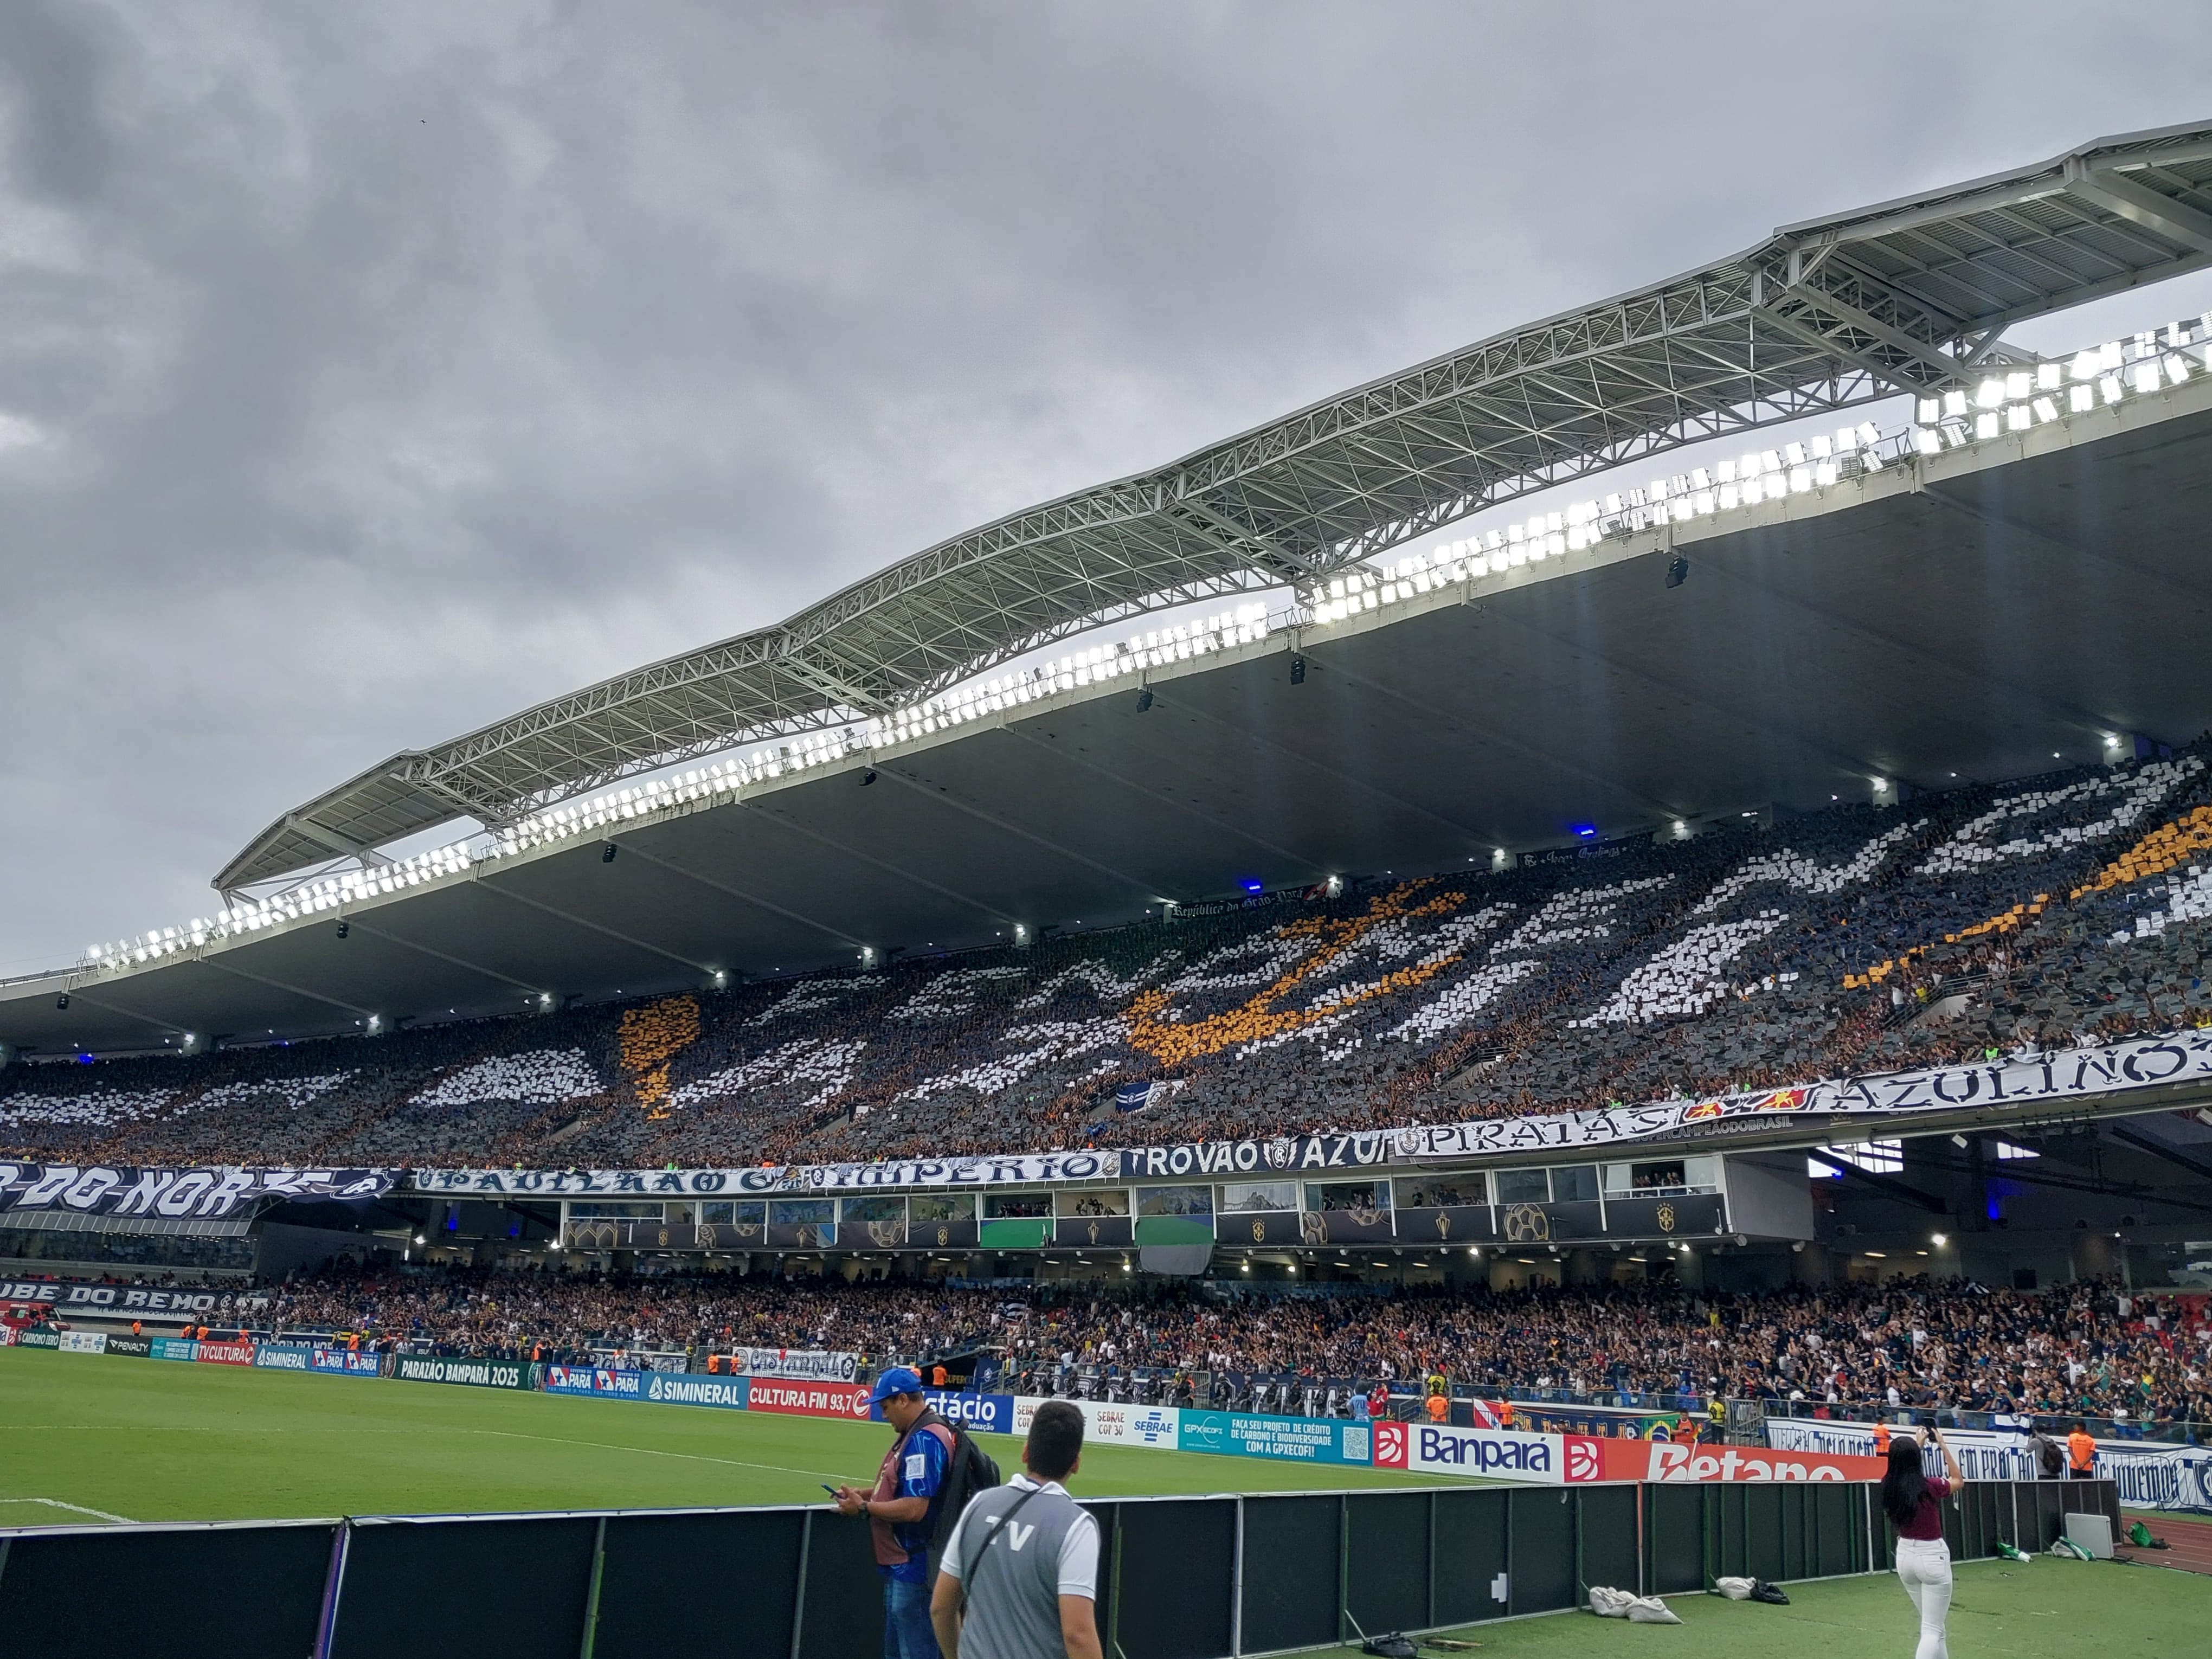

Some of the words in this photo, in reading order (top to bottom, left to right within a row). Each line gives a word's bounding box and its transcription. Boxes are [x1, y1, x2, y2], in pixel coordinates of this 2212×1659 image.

[1172, 904, 1223, 918] República
[1423, 1105, 1673, 1153] PIRATAS
[16, 1166, 119, 1208] DO
[113, 1172, 332, 1216] NOR
[67, 1287, 118, 1305] DO
[123, 1290, 216, 1311] REMO
[22, 1332, 46, 1345] CARBONO
[45, 1334, 59, 1346] ZERO
[117, 1342, 149, 1353] PENALTY
[265, 1352, 305, 1369] SIMINERAL
[401, 1359, 444, 1380] PARAZÃO
[445, 1362, 490, 1384] BANPARÁ
[491, 1366, 519, 1387] 2025
[664, 1381, 739, 1405] SIMINERAL
[749, 1387, 807, 1408] CULTURA
[808, 1392, 827, 1410] FM
[830, 1393, 852, 1414] 93,7
[924, 1392, 995, 1421] stácio
[1017, 1405, 1038, 1416] SEBR
[1097, 1411, 1125, 1423] SEBRAE
[1098, 1424, 1112, 1436] COP
[1114, 1425, 1123, 1437] 30
[1134, 1420, 1174, 1434] SEBRAE
[1232, 1419, 1248, 1430] FAÇA
[1249, 1420, 1262, 1430] SEU
[1263, 1422, 1290, 1433] PROJETO
[1293, 1423, 1301, 1433] DE
[1303, 1423, 1331, 1436] CRÉDITO
[1231, 1429, 1239, 1439] DE
[1240, 1430, 1271, 1441] CARBONO
[1271, 1433, 1277, 1442] E
[1277, 1432, 1332, 1446] BIODIVERSIDADE
[1246, 1441, 1264, 1454] COM
[1265, 1443, 1272, 1454] A
[1272, 1443, 1315, 1458] GPXECOFI!
[1420, 1428, 1551, 1474] Banpará
[986, 1515, 1034, 1552] TV
